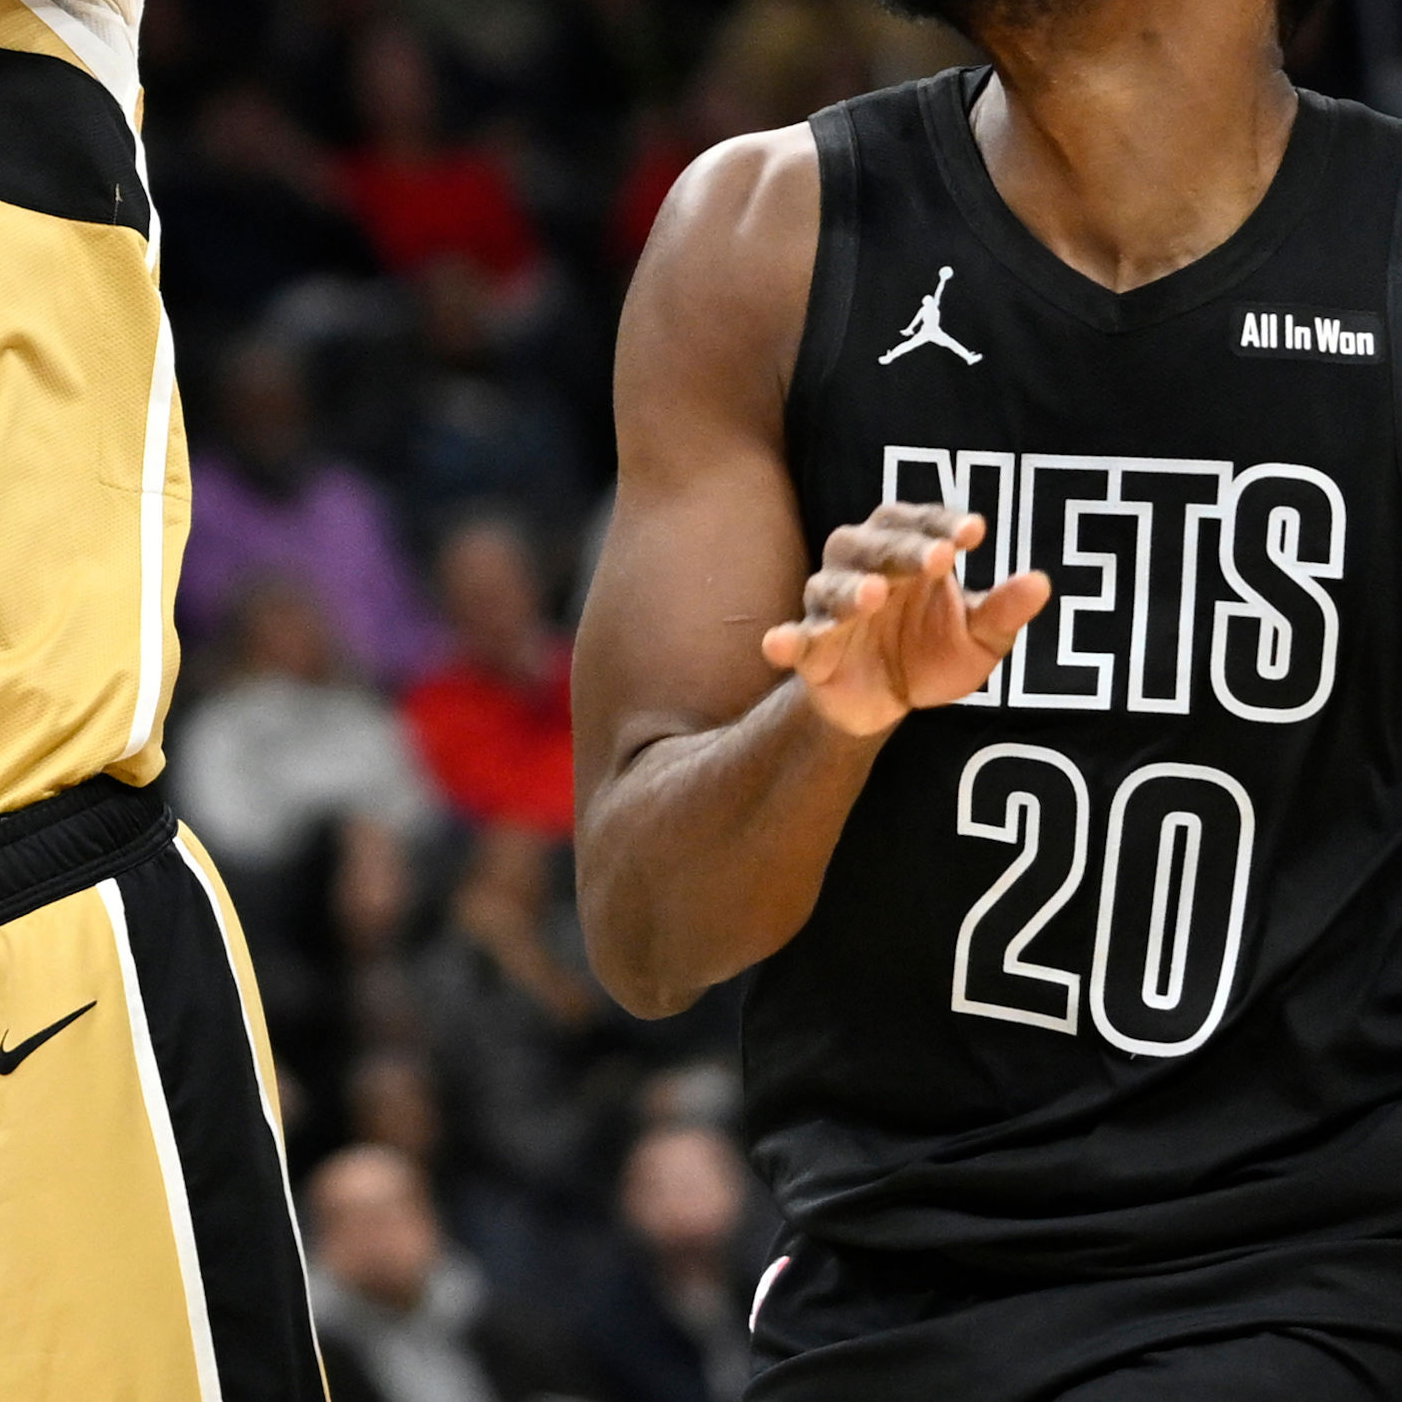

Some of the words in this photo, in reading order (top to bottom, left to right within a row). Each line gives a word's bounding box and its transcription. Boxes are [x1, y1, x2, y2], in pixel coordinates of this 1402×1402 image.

[1240, 312, 1278, 349] All
[1285, 313, 1312, 351] In
[1314, 316, 1375, 356] Won
[951, 742, 1256, 1058] 20
